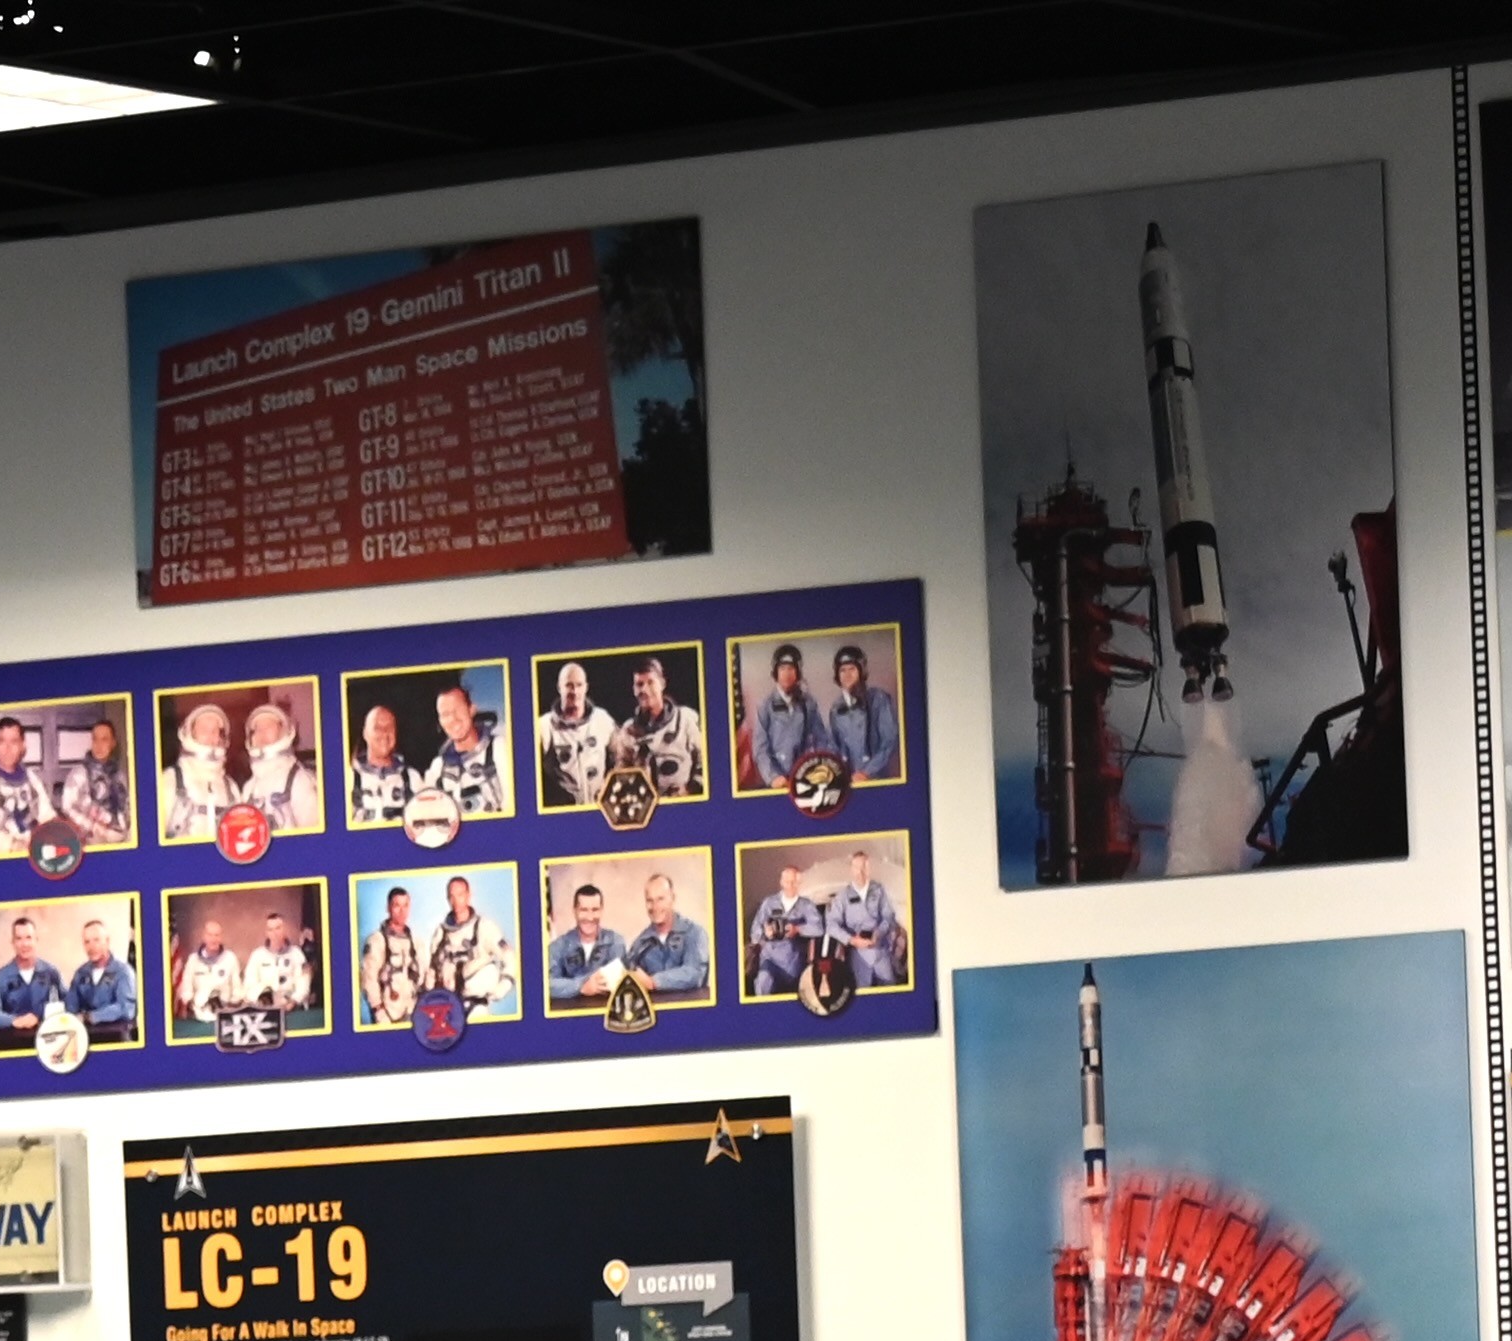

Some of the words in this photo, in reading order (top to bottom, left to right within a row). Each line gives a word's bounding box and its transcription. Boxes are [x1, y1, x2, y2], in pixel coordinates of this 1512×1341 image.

[172, 350, 236, 384] Launch
[245, 324, 336, 365] Complex
[381, 280, 464, 326] Gemini
[474, 262, 541, 300] Titan
[261, 386, 315, 413] States
[415, 345, 478, 377] Space
[487, 317, 588, 359] Missions
[161, 1208, 237, 1232] LAUNCH
[251, 1200, 343, 1226] COMPLEX
[162, 1225, 367, 1310] LC-19
[637, 1273, 717, 1294] LOCATION
[211, 1323, 236, 1341] For
[238, 1321, 250, 1340] A
[252, 1319, 291, 1339] Walk
[292, 1318, 307, 1337] In
[310, 1317, 356, 1340] Space
